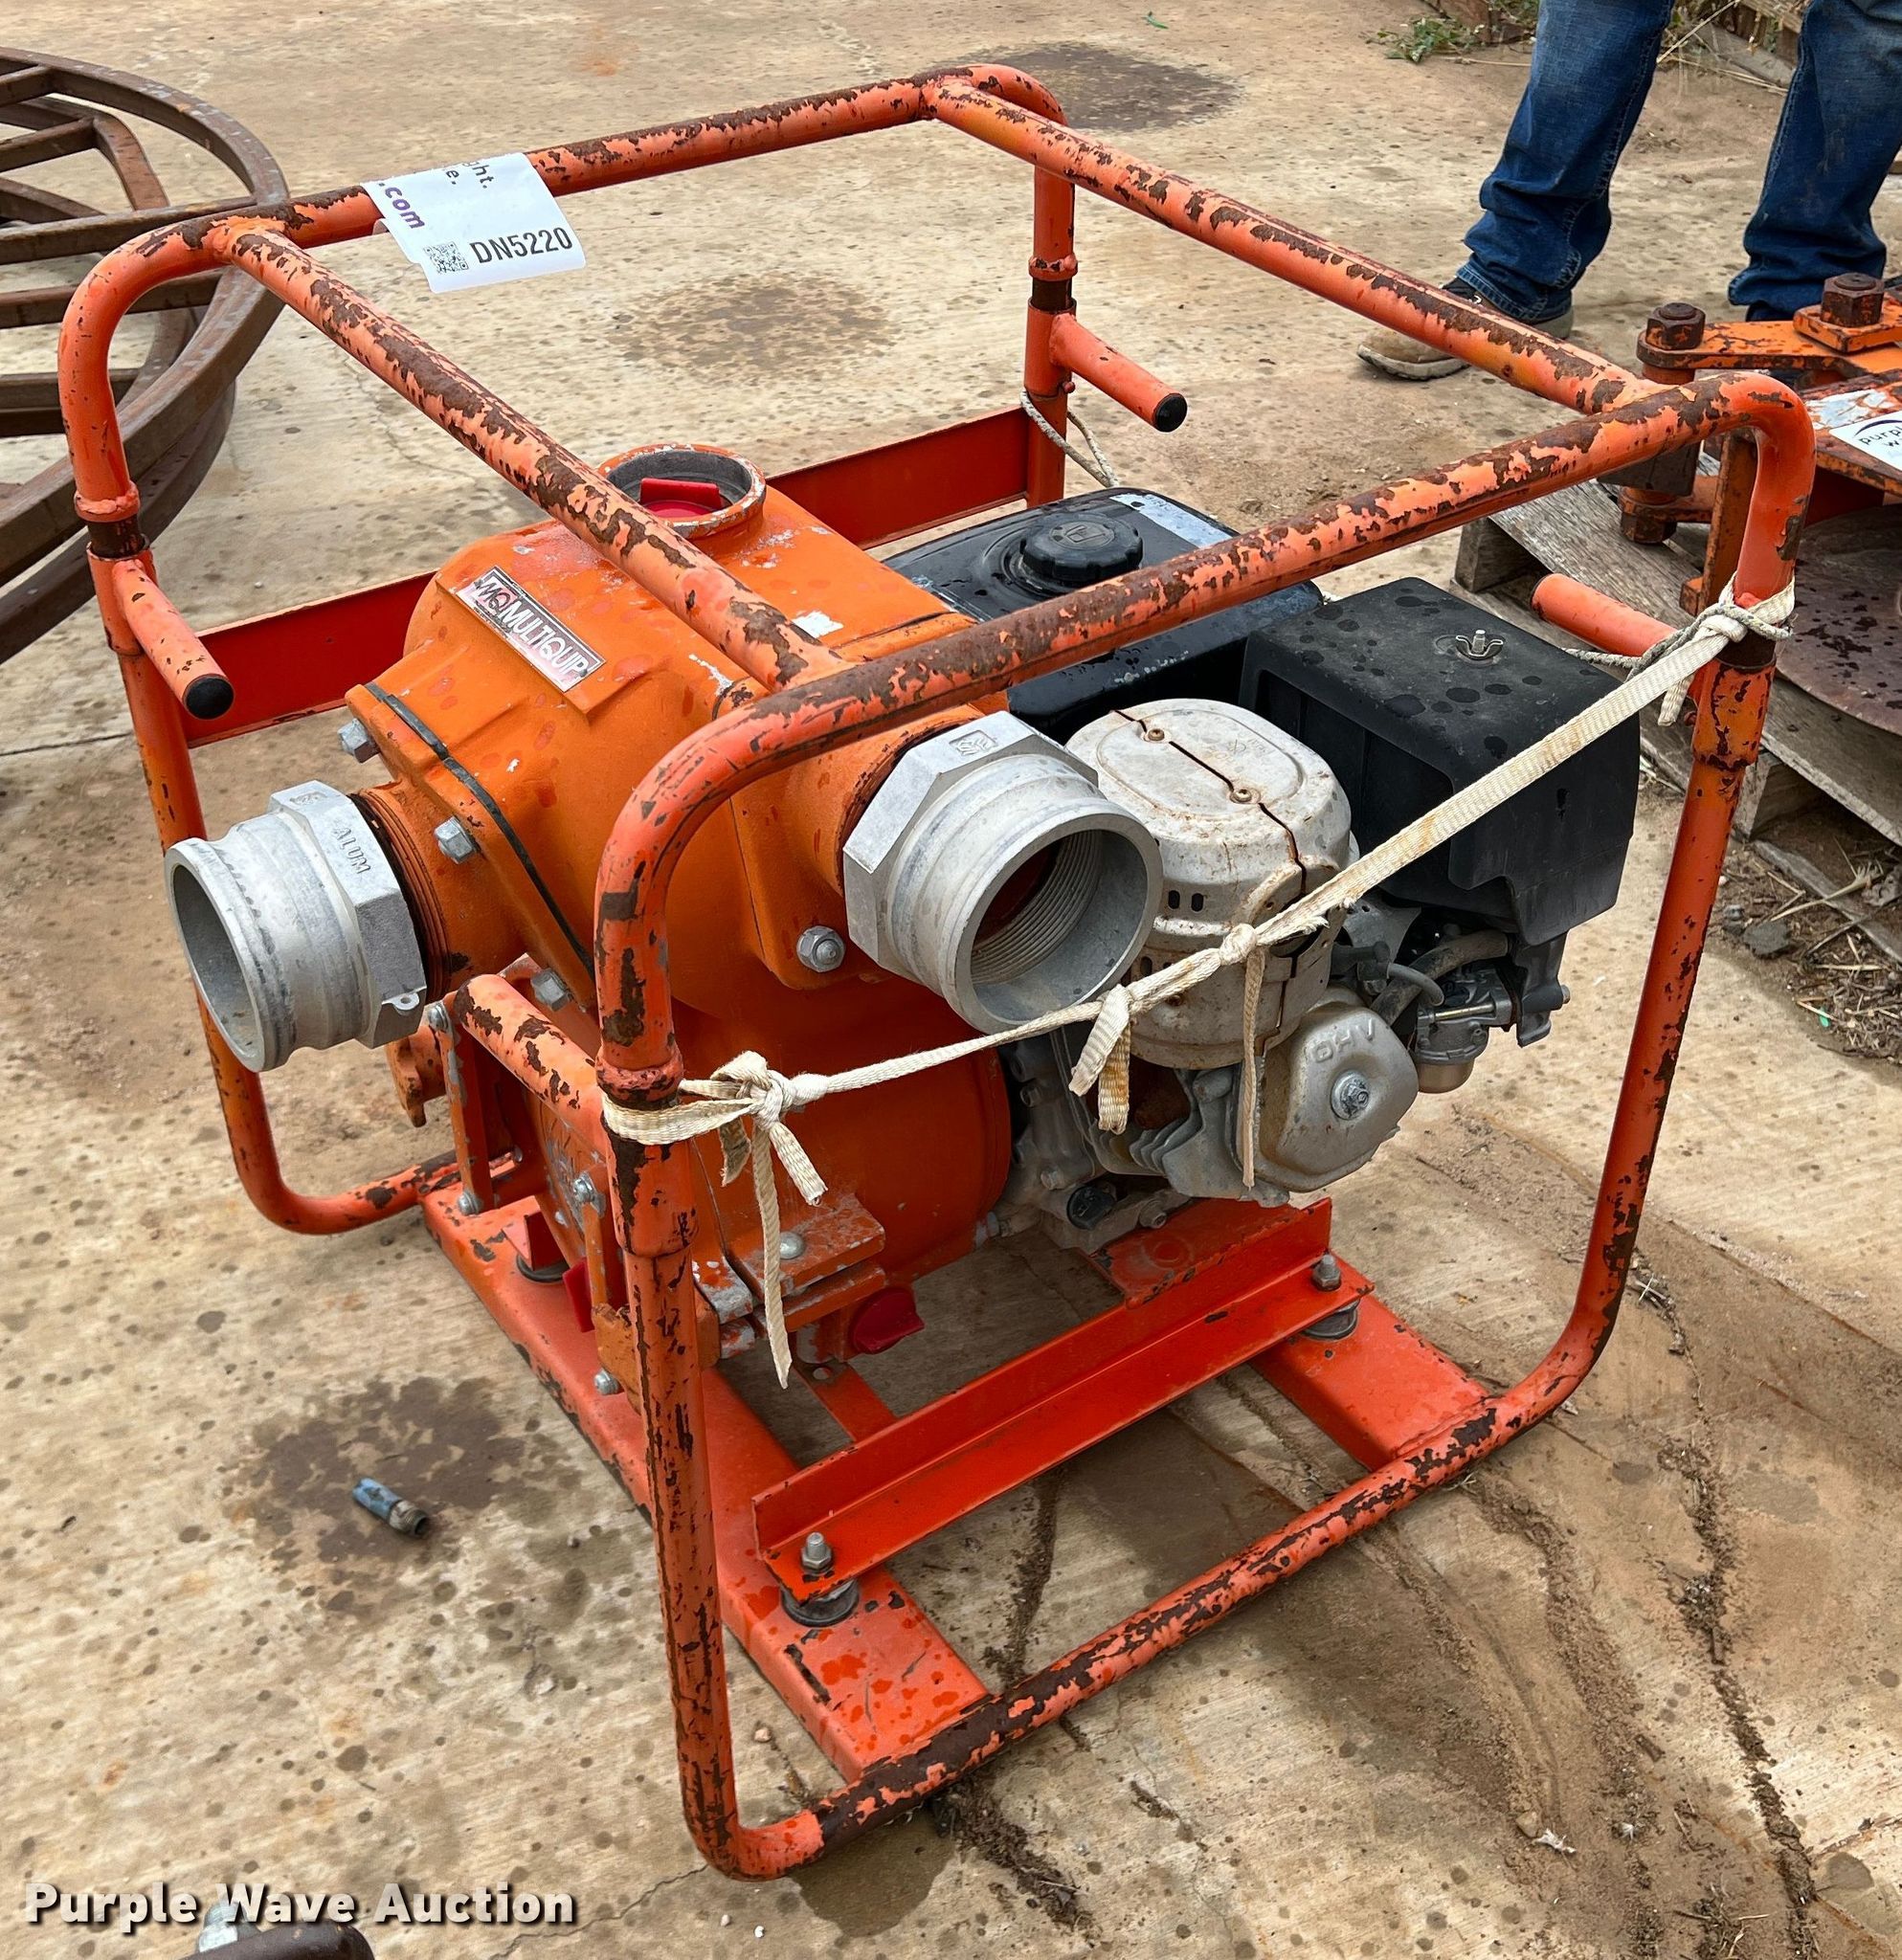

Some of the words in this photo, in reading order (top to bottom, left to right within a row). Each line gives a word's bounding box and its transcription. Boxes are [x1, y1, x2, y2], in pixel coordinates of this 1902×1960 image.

[378, 182, 425, 229] .com
[469, 227, 573, 264] DN5220
[497, 600, 591, 676] MULTIQUIP
[335, 827, 371, 875] ALUM
[1311, 1018, 1376, 1063] OHV
